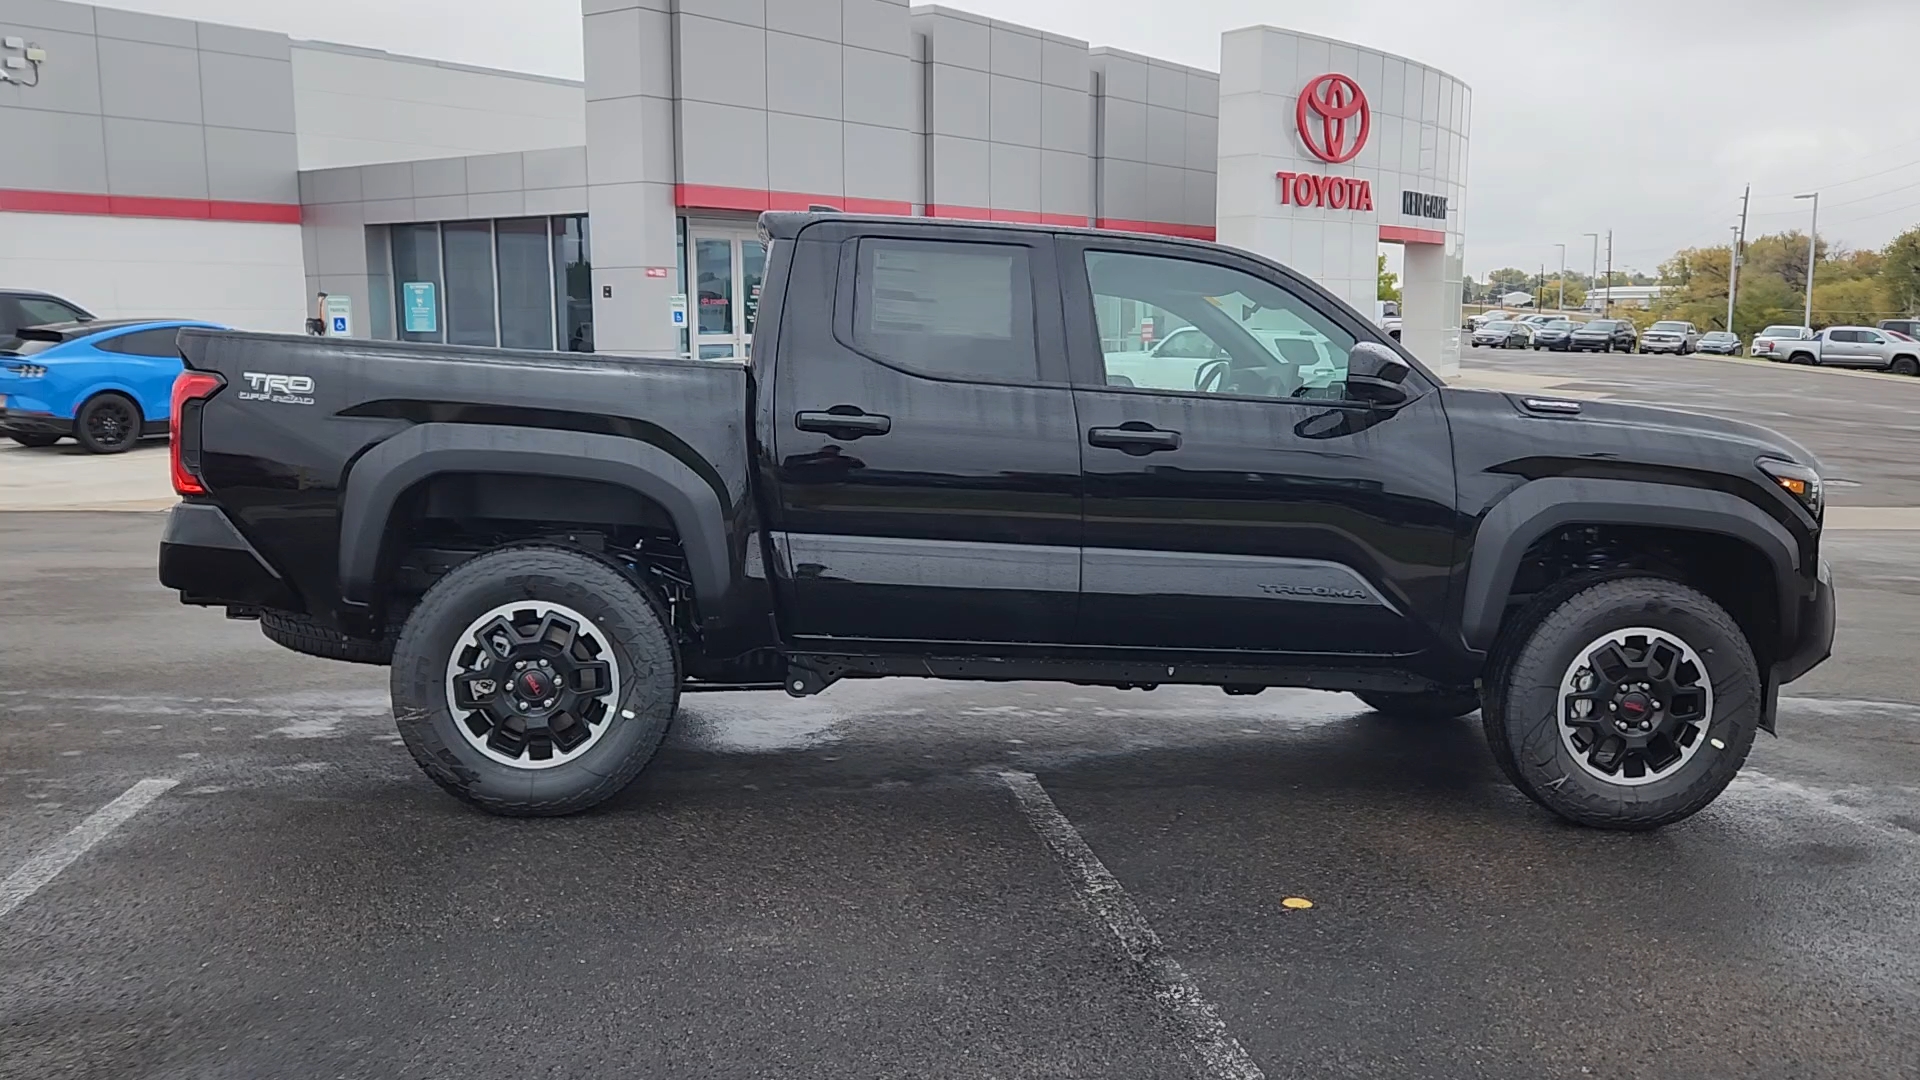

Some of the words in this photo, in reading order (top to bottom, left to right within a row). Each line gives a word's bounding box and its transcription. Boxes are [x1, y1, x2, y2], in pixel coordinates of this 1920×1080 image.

[1275, 171, 1374, 212] TOYOTA
[1402, 190, 1423, 217] KEN
[242, 371, 316, 395] TRD
[1256, 583, 1367, 600] TACOMA
